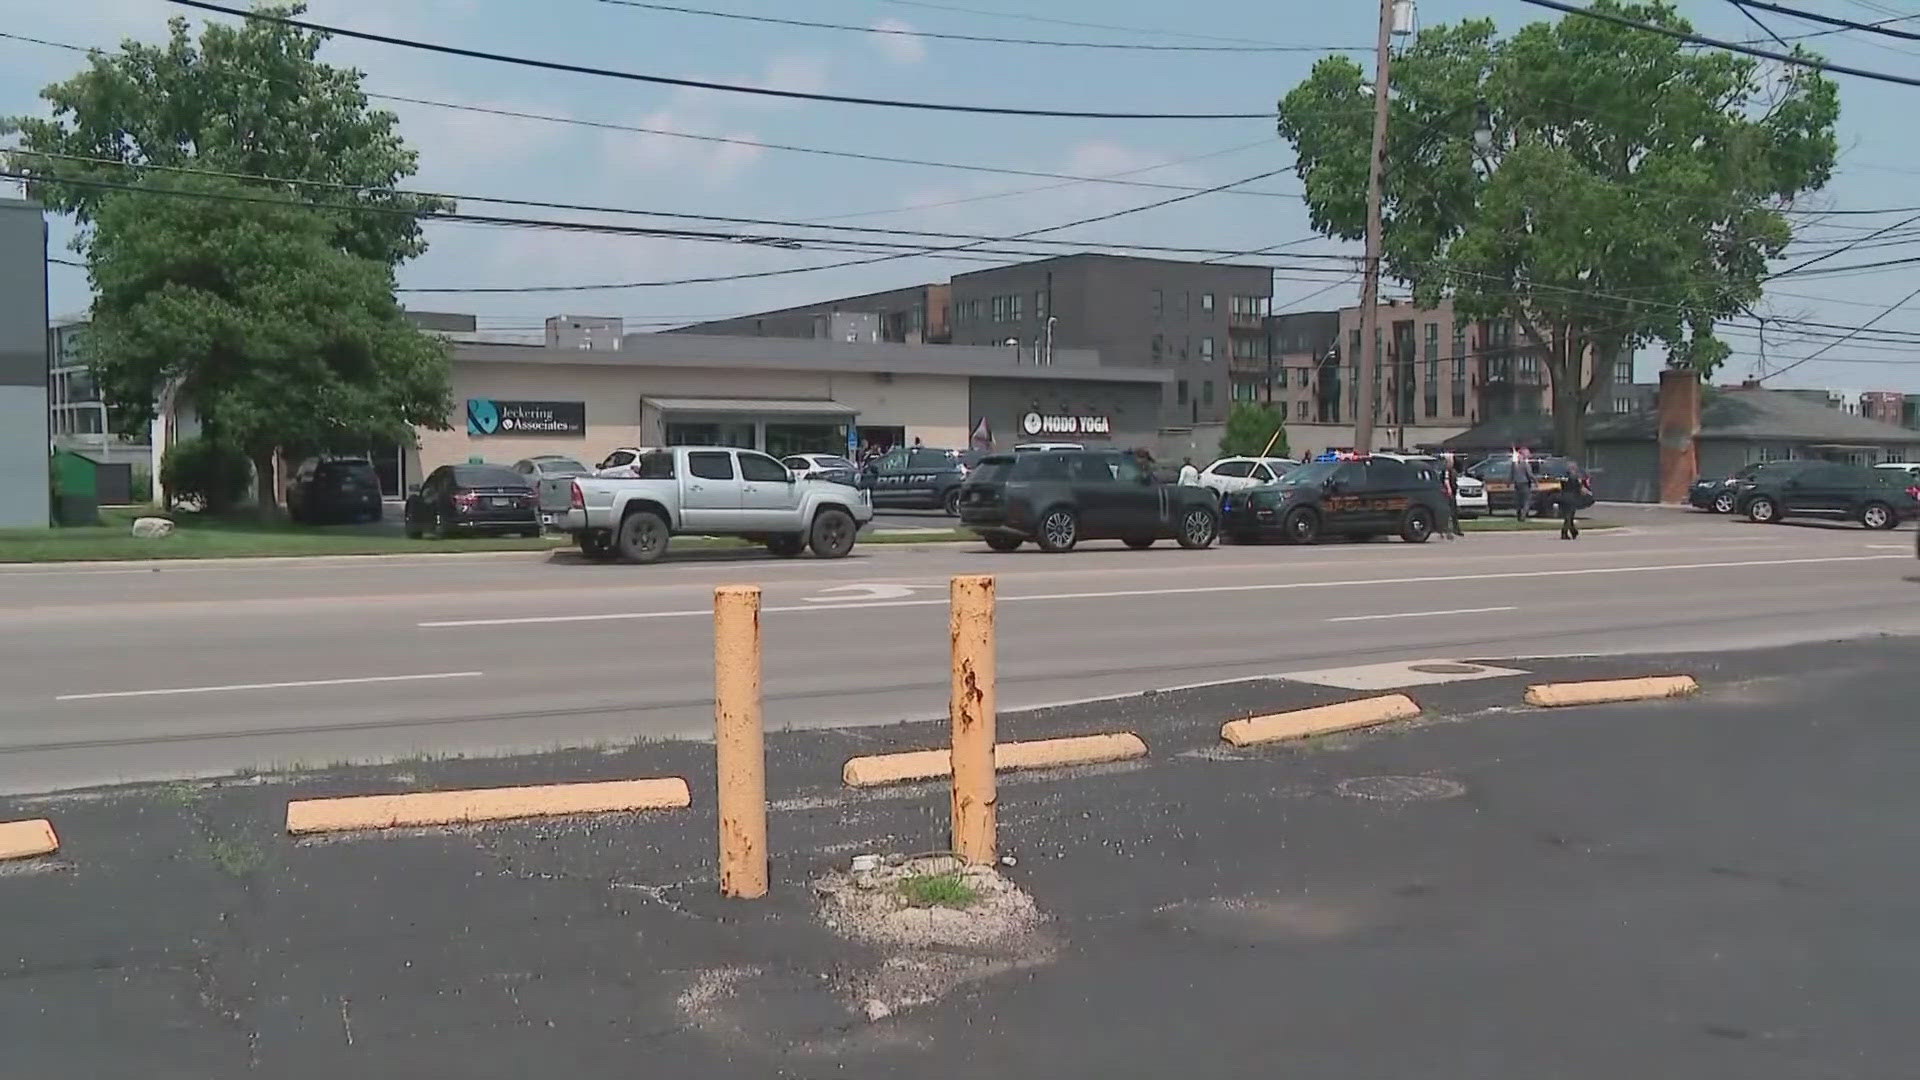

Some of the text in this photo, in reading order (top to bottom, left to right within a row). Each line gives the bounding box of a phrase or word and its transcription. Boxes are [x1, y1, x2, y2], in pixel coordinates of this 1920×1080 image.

[514, 419, 568, 430] Associates
[1043, 415, 1109, 432] MODO YOGA
